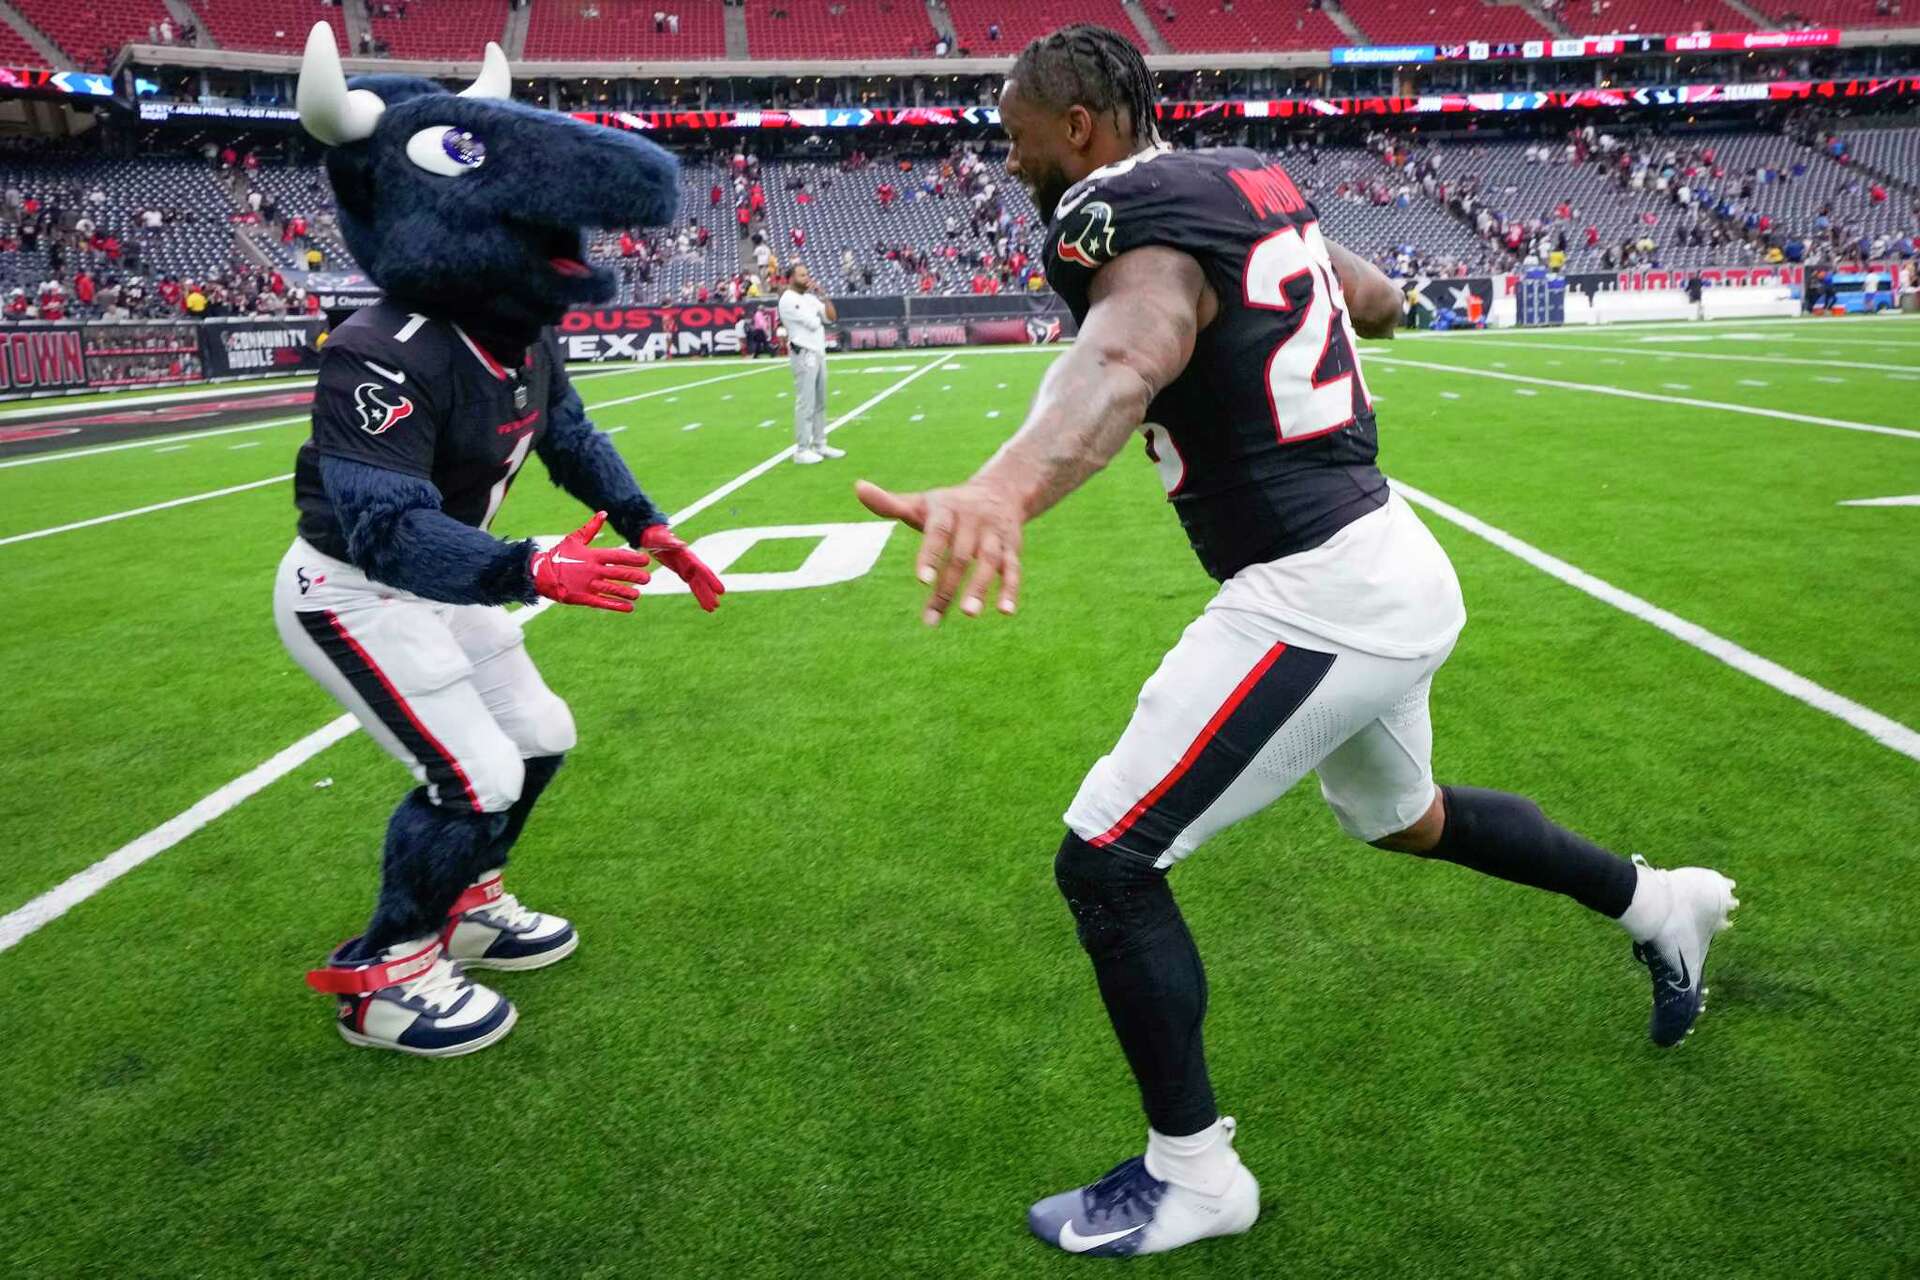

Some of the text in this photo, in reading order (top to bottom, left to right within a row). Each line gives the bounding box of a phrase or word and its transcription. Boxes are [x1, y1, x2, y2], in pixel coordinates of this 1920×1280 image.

[393, 313, 430, 343] 1
[555, 306, 745, 333] OUSTON
[230, 329, 307, 350] COMMUNITY
[558, 329, 742, 359] EXANS
